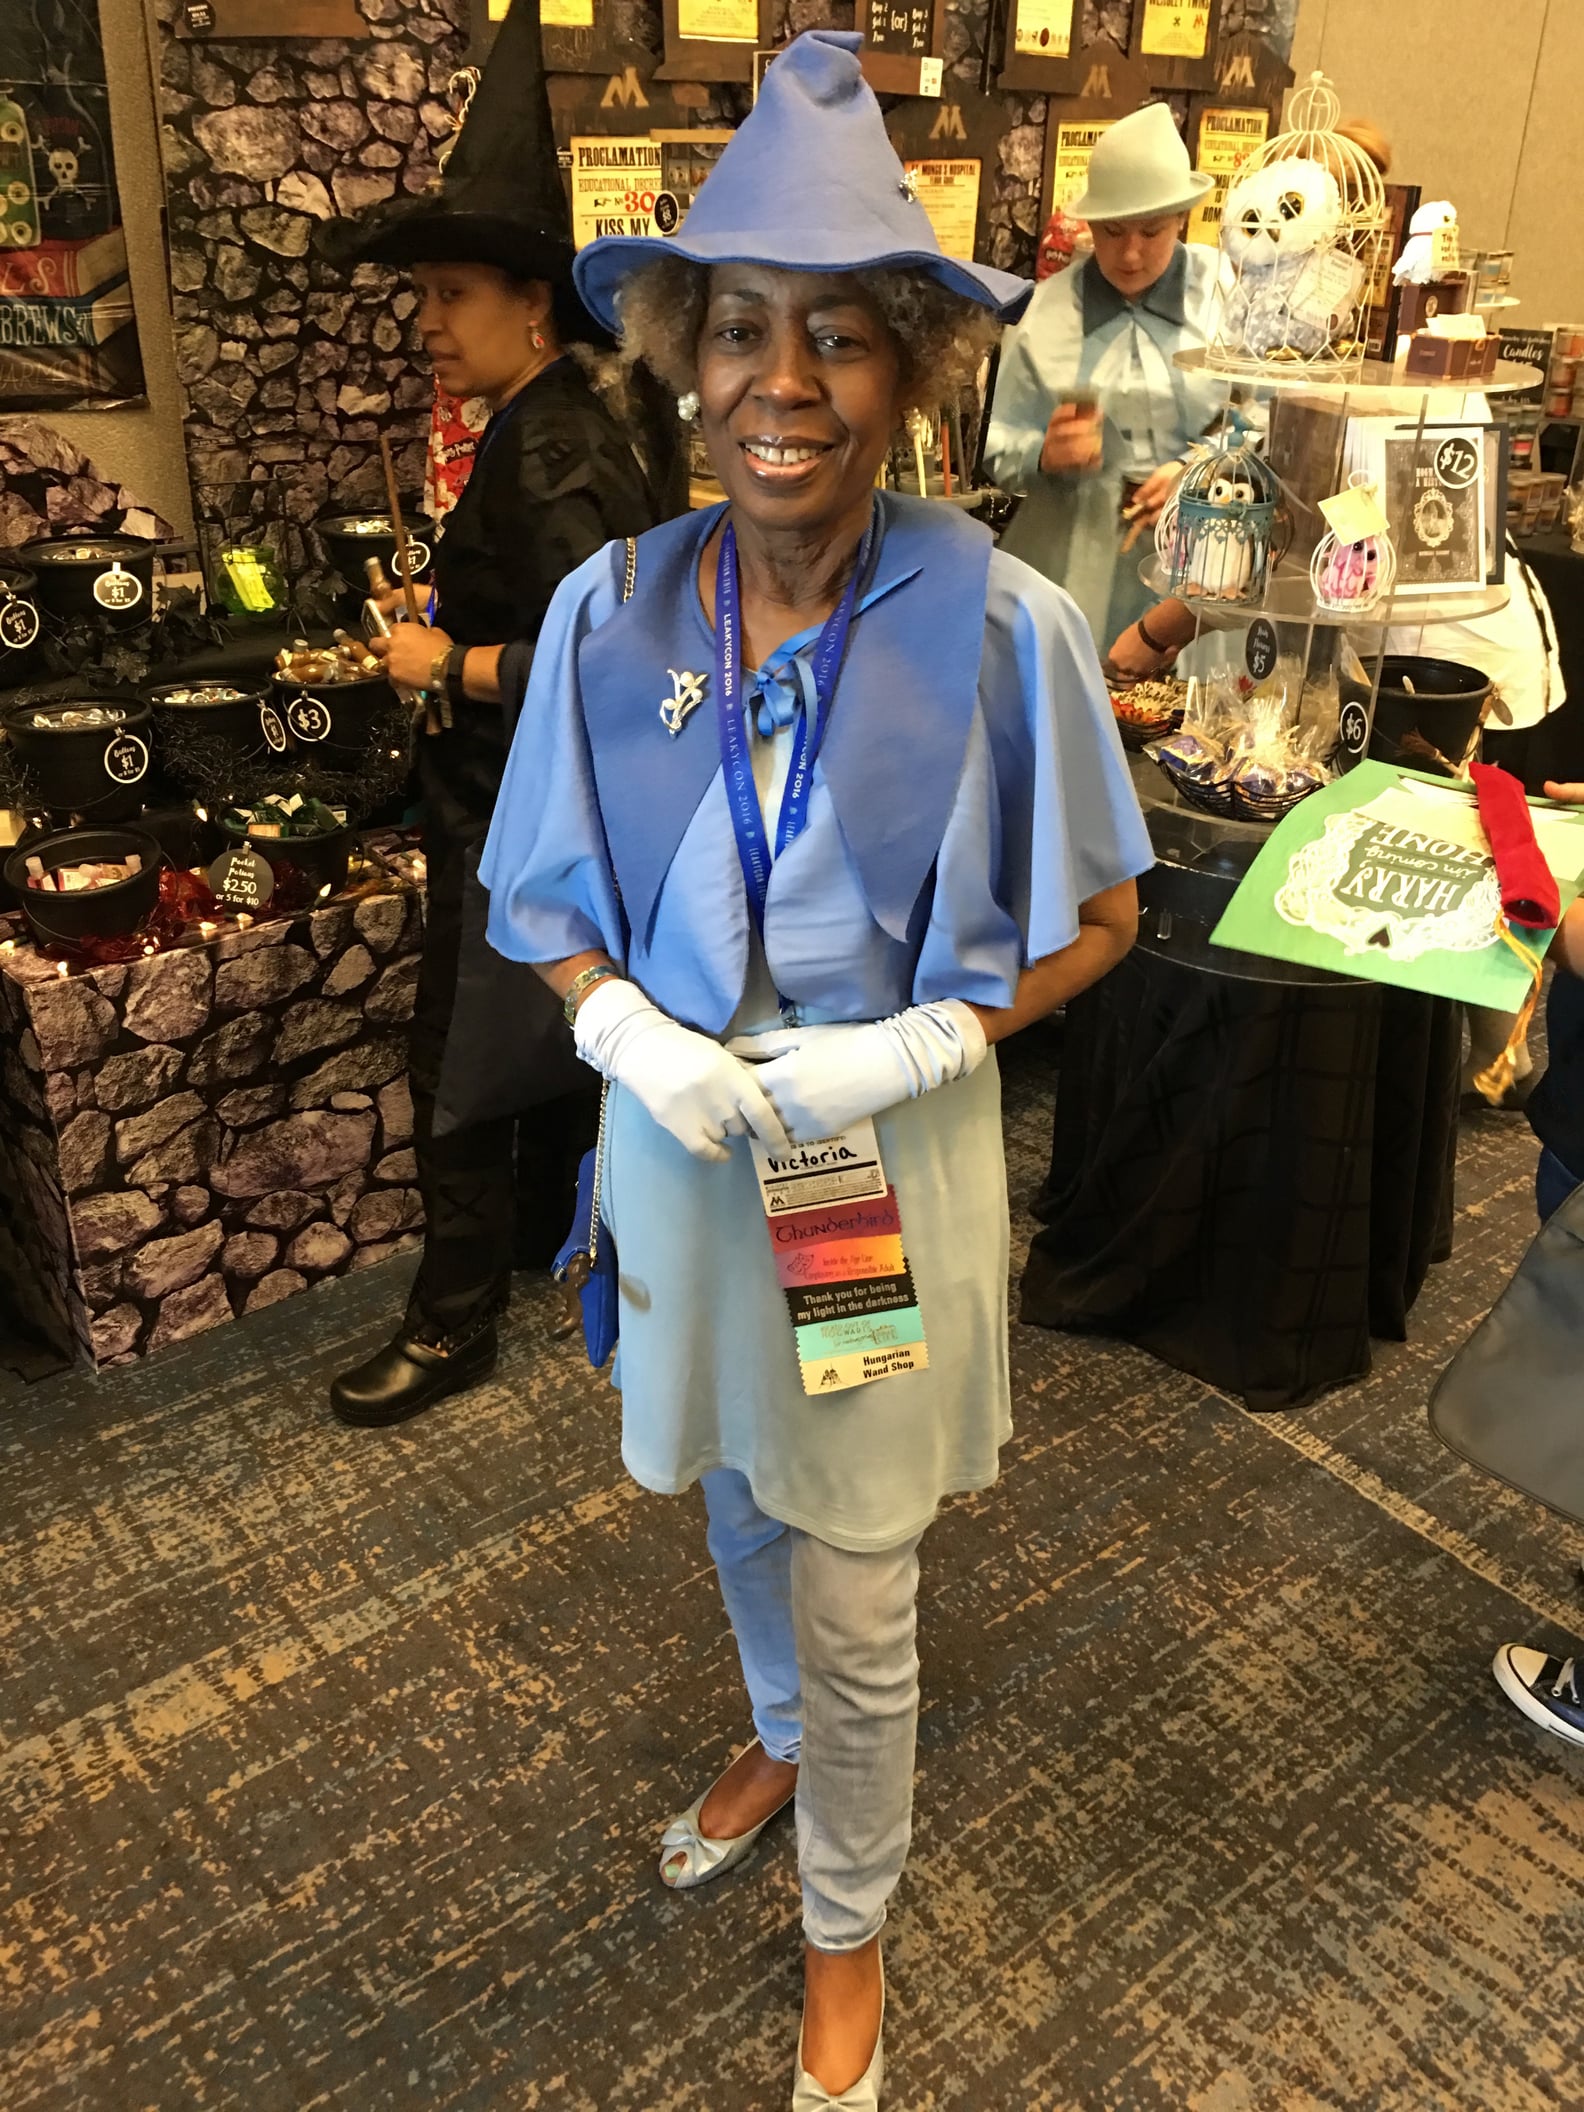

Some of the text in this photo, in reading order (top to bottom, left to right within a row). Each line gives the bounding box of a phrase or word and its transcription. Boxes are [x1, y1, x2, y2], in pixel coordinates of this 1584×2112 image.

[1206, 116, 1263, 134] PROCLAMATION
[1061, 131, 1104, 147] PROCLAMA
[578, 147, 661, 167] PROCLAMATION
[578, 178, 631, 192] EDUCATIONAL
[624, 191, 656, 213] 30
[596, 218, 650, 237] KISS MY
[1503, 344, 1544, 361] Candles
[1439, 443, 1475, 480] $12
[111, 587, 125, 599] $1
[817, 600, 846, 687] AKYCON 2016
[723, 613, 733, 697] LEAKYCON 2016
[1253, 652, 1266, 673] $5
[297, 708, 322, 731] $3
[1346, 713, 1363, 741] $6
[121, 754, 134, 770] $1
[726, 719, 753, 825] LEAKYCON 2016
[792, 773, 804, 799] 2016
[1370, 823, 1491, 866] HOME
[230, 857, 256, 868] Pocket
[1365, 846, 1439, 871] coming
[1339, 860, 1462, 911] HARRY,
[226, 893, 231, 902] 5
[232, 894, 244, 903] for
[246, 897, 259, 906] $10
[768, 1146, 858, 1173] Victoria
[776, 1209, 894, 1243] Thunderbird
[803, 1282, 897, 1305] Thank you for being
[797, 1293, 910, 1321] my light in the darkness
[863, 1349, 911, 1366] Hungarian
[863, 1361, 915, 1379] Wand Shop
